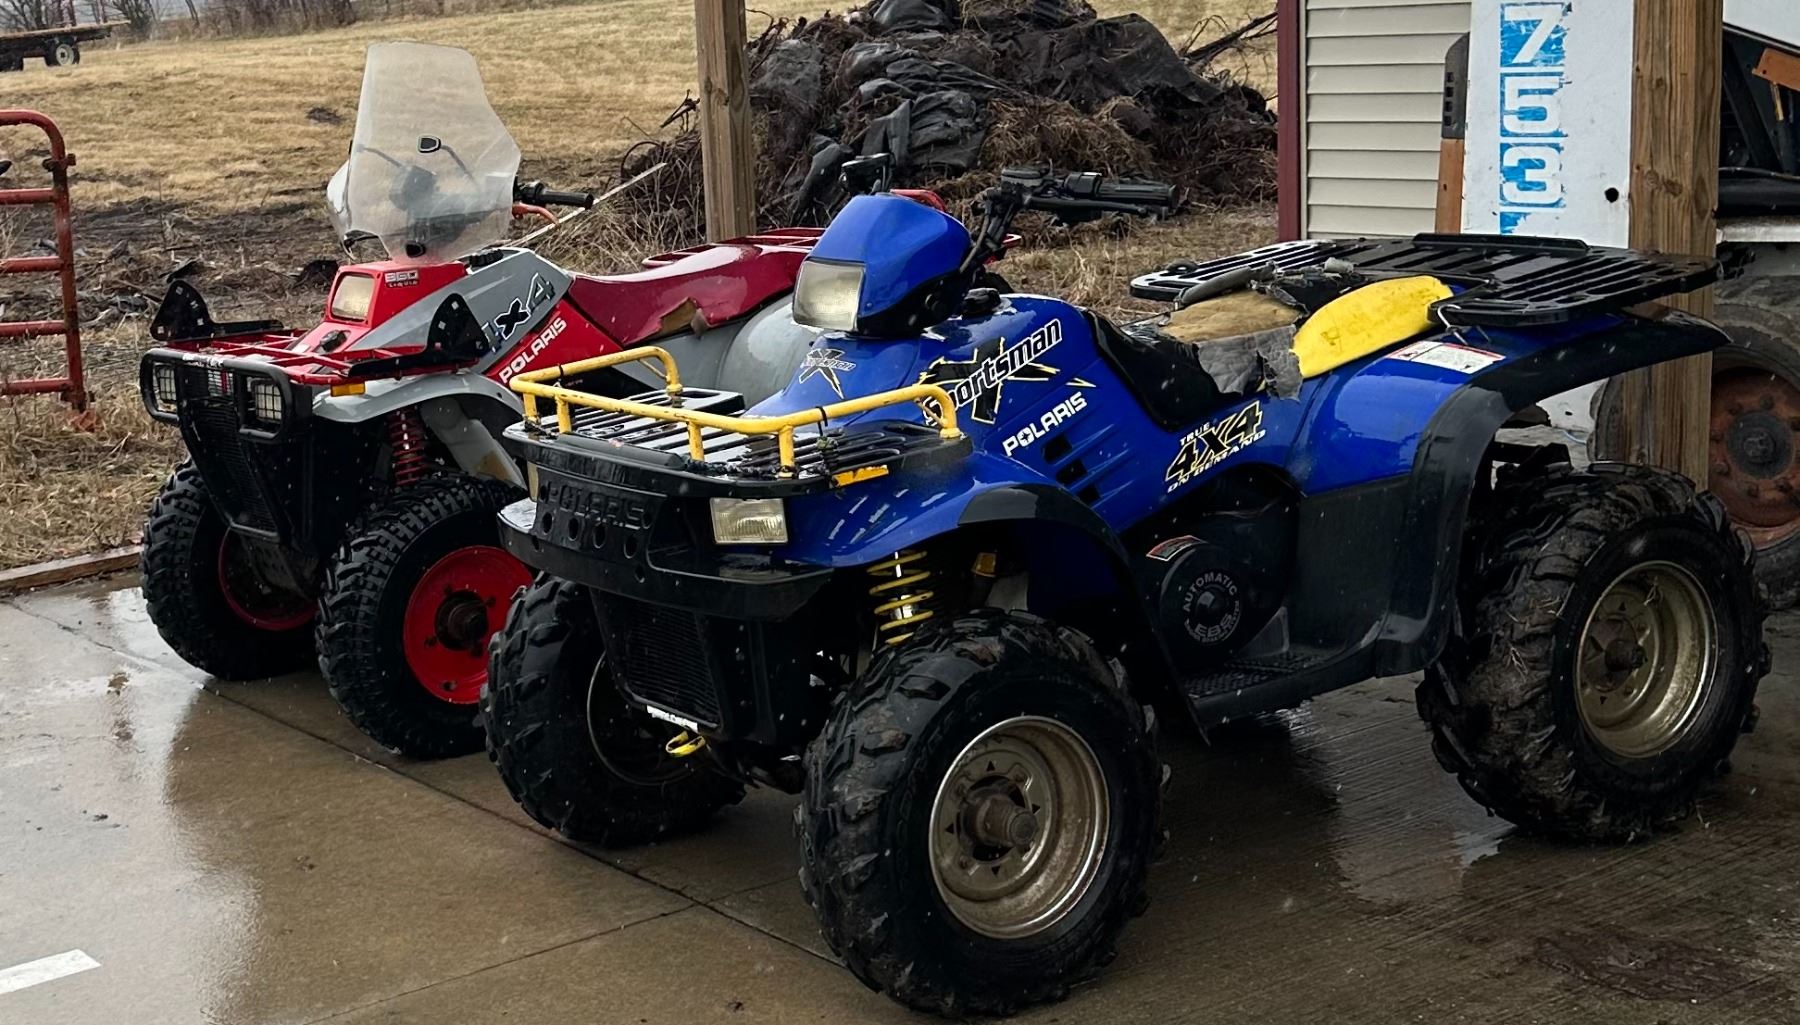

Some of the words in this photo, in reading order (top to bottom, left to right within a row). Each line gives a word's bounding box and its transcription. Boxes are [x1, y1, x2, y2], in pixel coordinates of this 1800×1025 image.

[499, 317, 567, 384] POLARIS
[1002, 391, 1088, 457] POLARIS
[1180, 422, 1210, 446] TRUE
[1167, 474, 1190, 493] ON
[1193, 429, 1267, 477] DEMAND
[1182, 571, 1238, 612] AUTOMATIC
[1195, 613, 1232, 637] EBS
